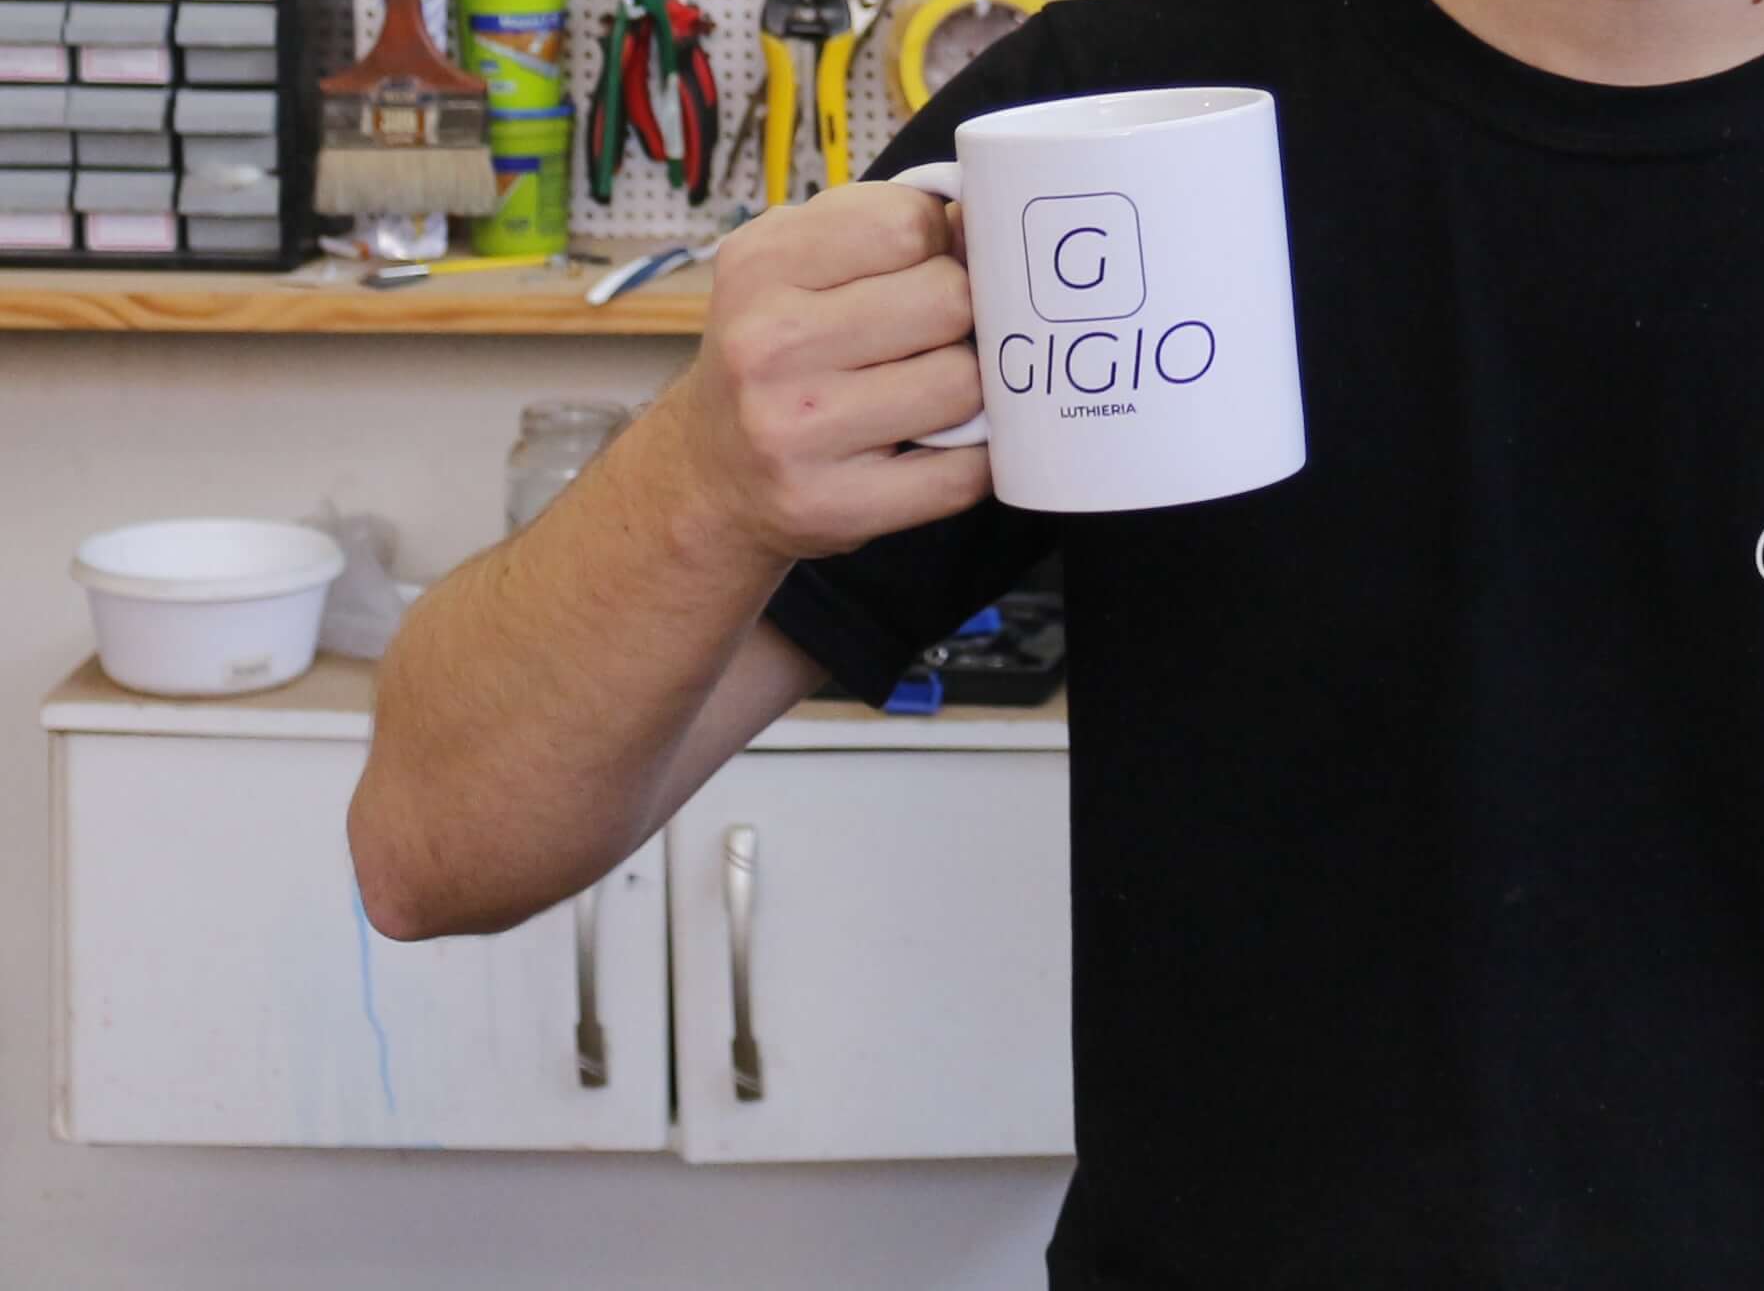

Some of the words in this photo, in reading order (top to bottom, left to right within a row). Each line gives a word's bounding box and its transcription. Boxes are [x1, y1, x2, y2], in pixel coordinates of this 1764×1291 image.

[1053, 227, 1107, 290] G
[998, 320, 1215, 395] GIGIO
[1060, 403, 1136, 419] LUTHIERIA
